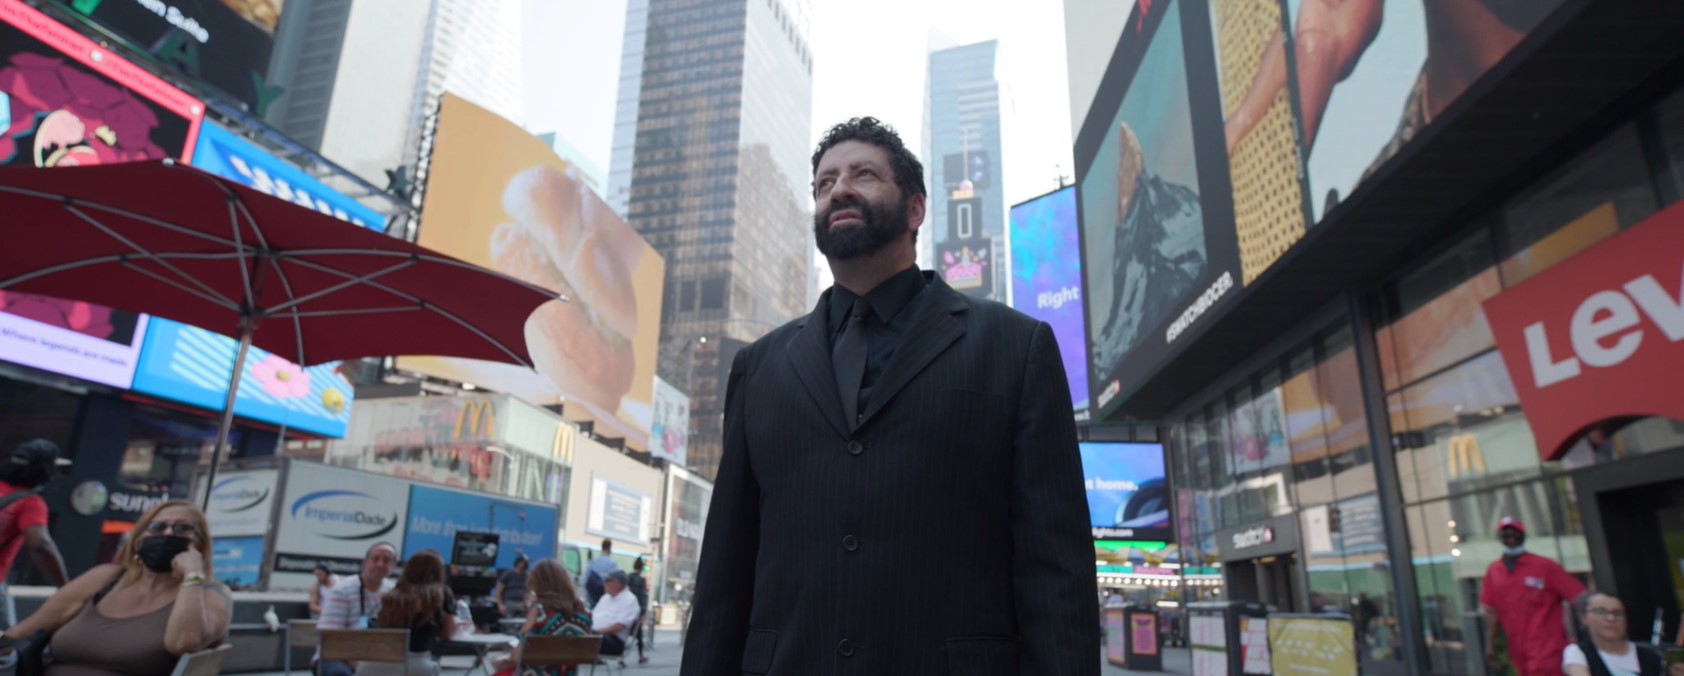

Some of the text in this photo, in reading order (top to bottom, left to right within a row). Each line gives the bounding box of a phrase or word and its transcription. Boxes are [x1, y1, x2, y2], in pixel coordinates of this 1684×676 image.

[165, 6, 210, 44] Suite
[1037, 285, 1080, 310] Right
[1095, 476, 1139, 492] home.
[303, 506, 387, 526] ImperialDade
[411, 514, 442, 537] More
